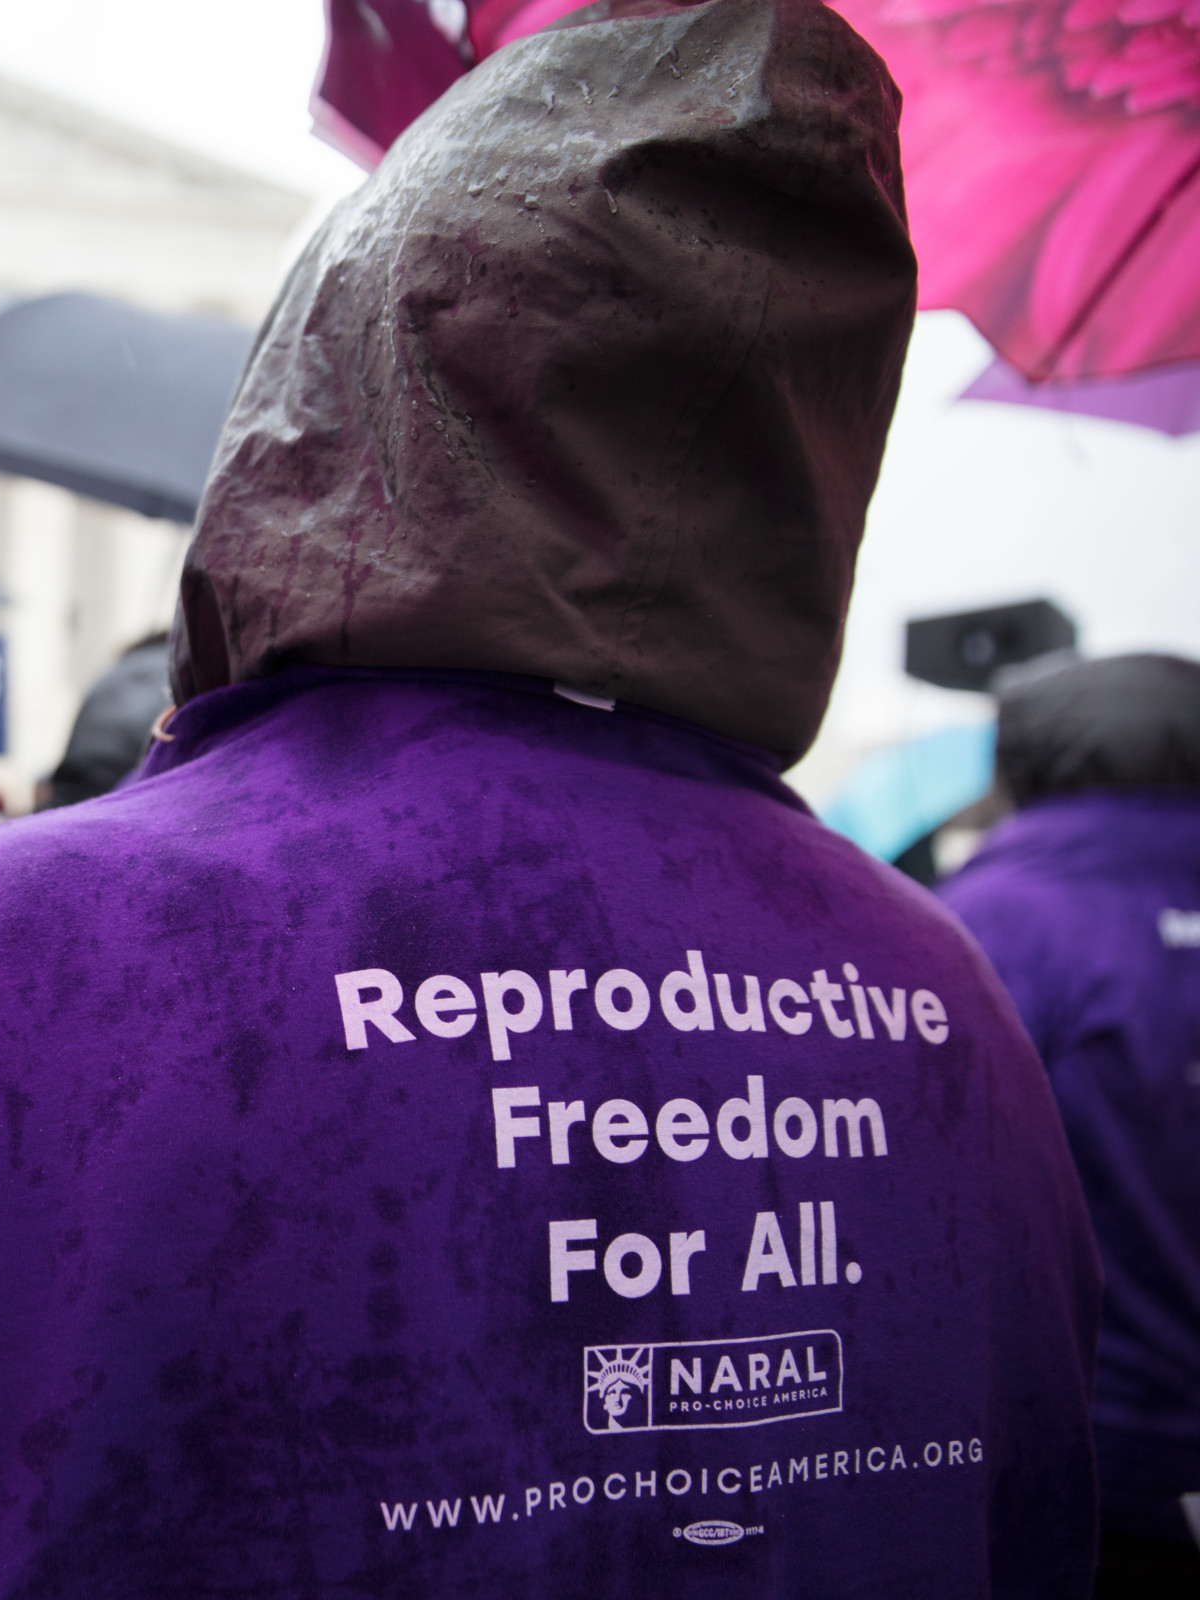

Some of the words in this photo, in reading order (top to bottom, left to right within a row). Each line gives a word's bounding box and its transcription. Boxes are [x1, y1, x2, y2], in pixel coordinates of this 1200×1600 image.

[335, 950, 949, 1061] Reproductive
[492, 1075, 888, 1168] Freedom
[549, 1218, 706, 1302] For
[742, 1201, 862, 1291] All.
[669, 1396, 767, 1412] PRO-CHOICE
[773, 1386, 828, 1404] AMERICA
[670, 1346, 827, 1396] NARAL
[381, 1438, 983, 1531] WWW.PROCHOICEAMERICA.ORG
